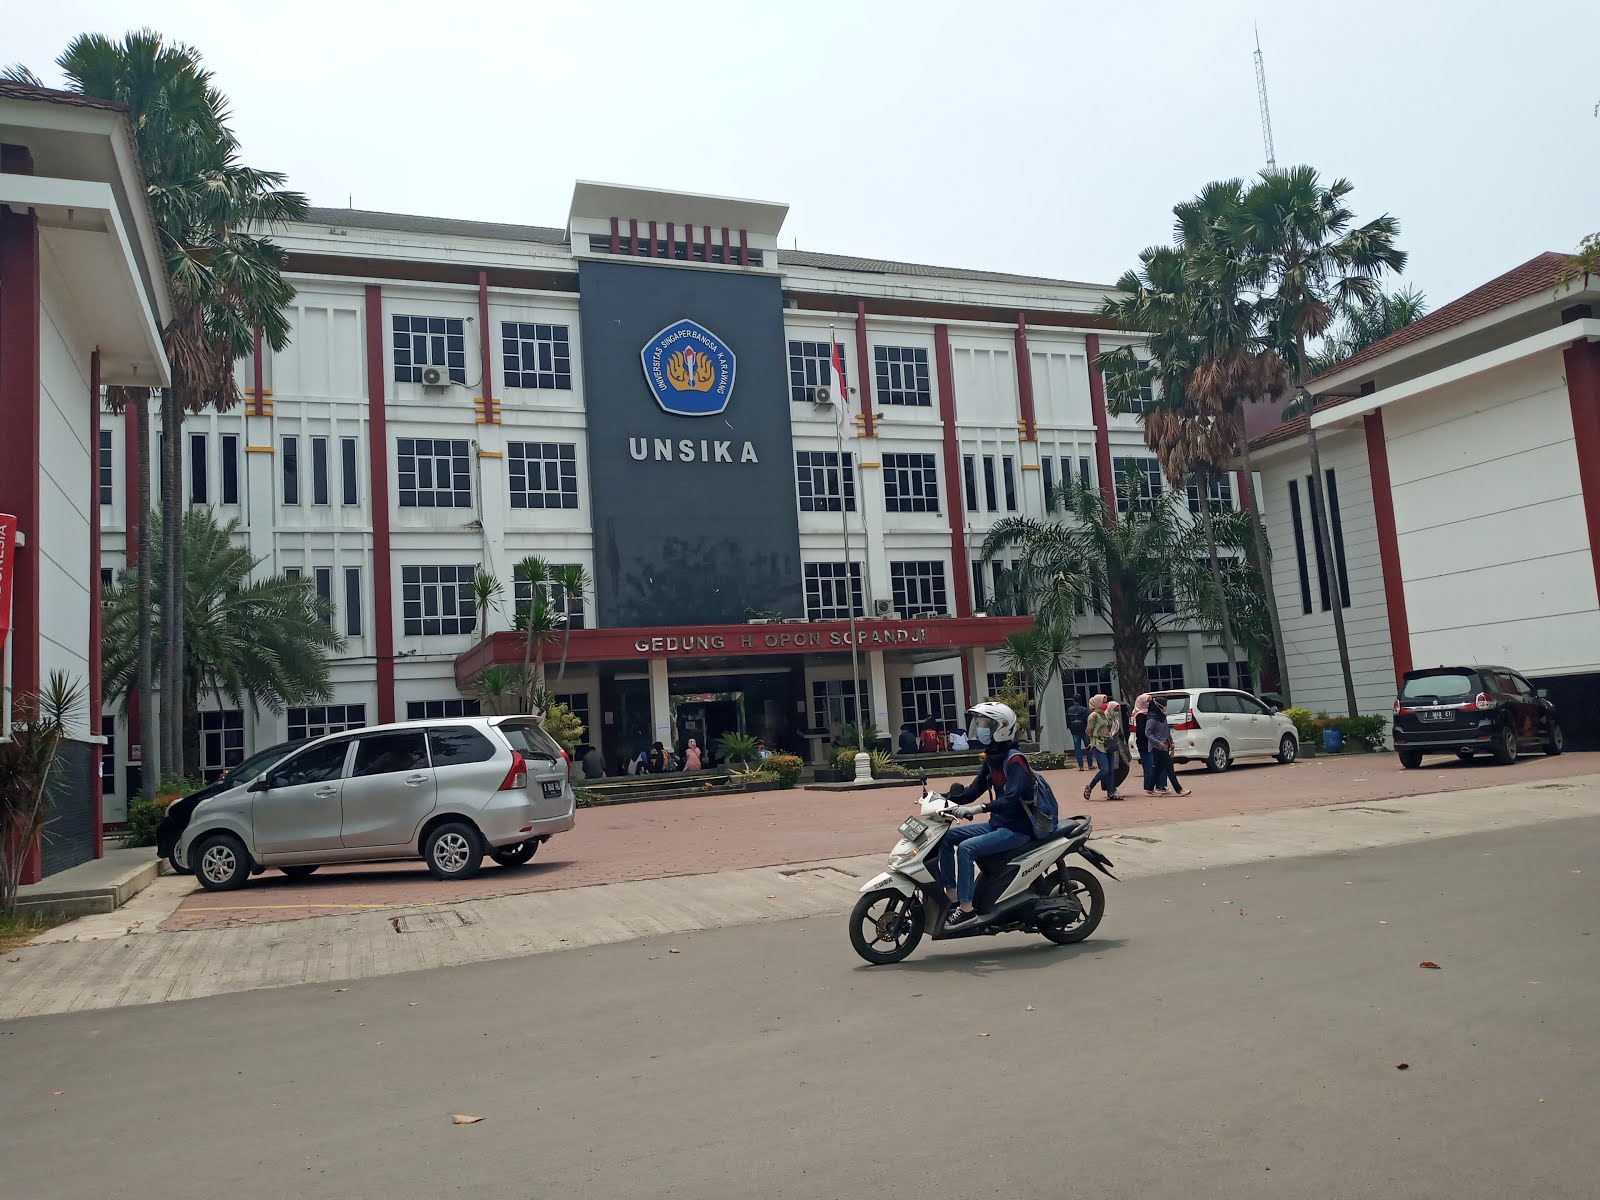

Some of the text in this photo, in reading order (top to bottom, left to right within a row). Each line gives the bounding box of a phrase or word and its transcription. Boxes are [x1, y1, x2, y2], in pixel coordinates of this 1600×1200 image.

[652, 329, 729, 395] UNIVERSITAS SINGAPERBANGSA KARAWANG
[629, 437, 759, 463] UNSIKA
[634, 635, 725, 652] GEDUNG
[740, 633, 753, 648] H
[764, 632, 821, 647] OPON
